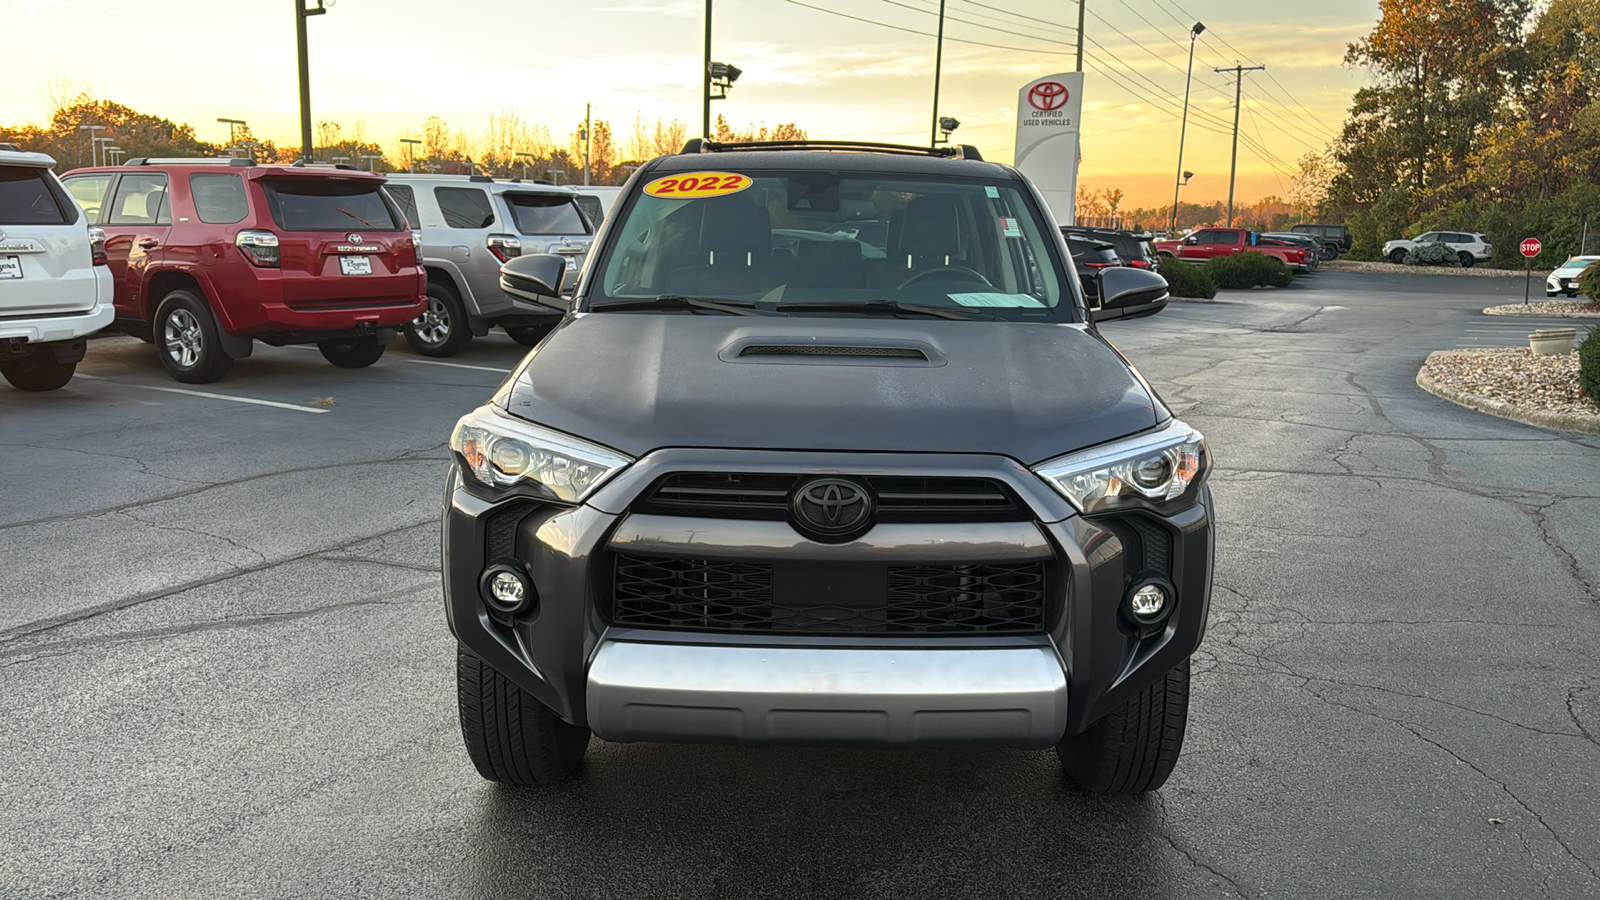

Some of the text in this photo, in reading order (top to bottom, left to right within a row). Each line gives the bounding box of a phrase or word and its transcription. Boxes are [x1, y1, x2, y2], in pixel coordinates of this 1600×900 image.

[1031, 110, 1063, 118] CERTIFIED
[655, 176, 743, 194] 2022
[1521, 243, 1541, 252] STOP
